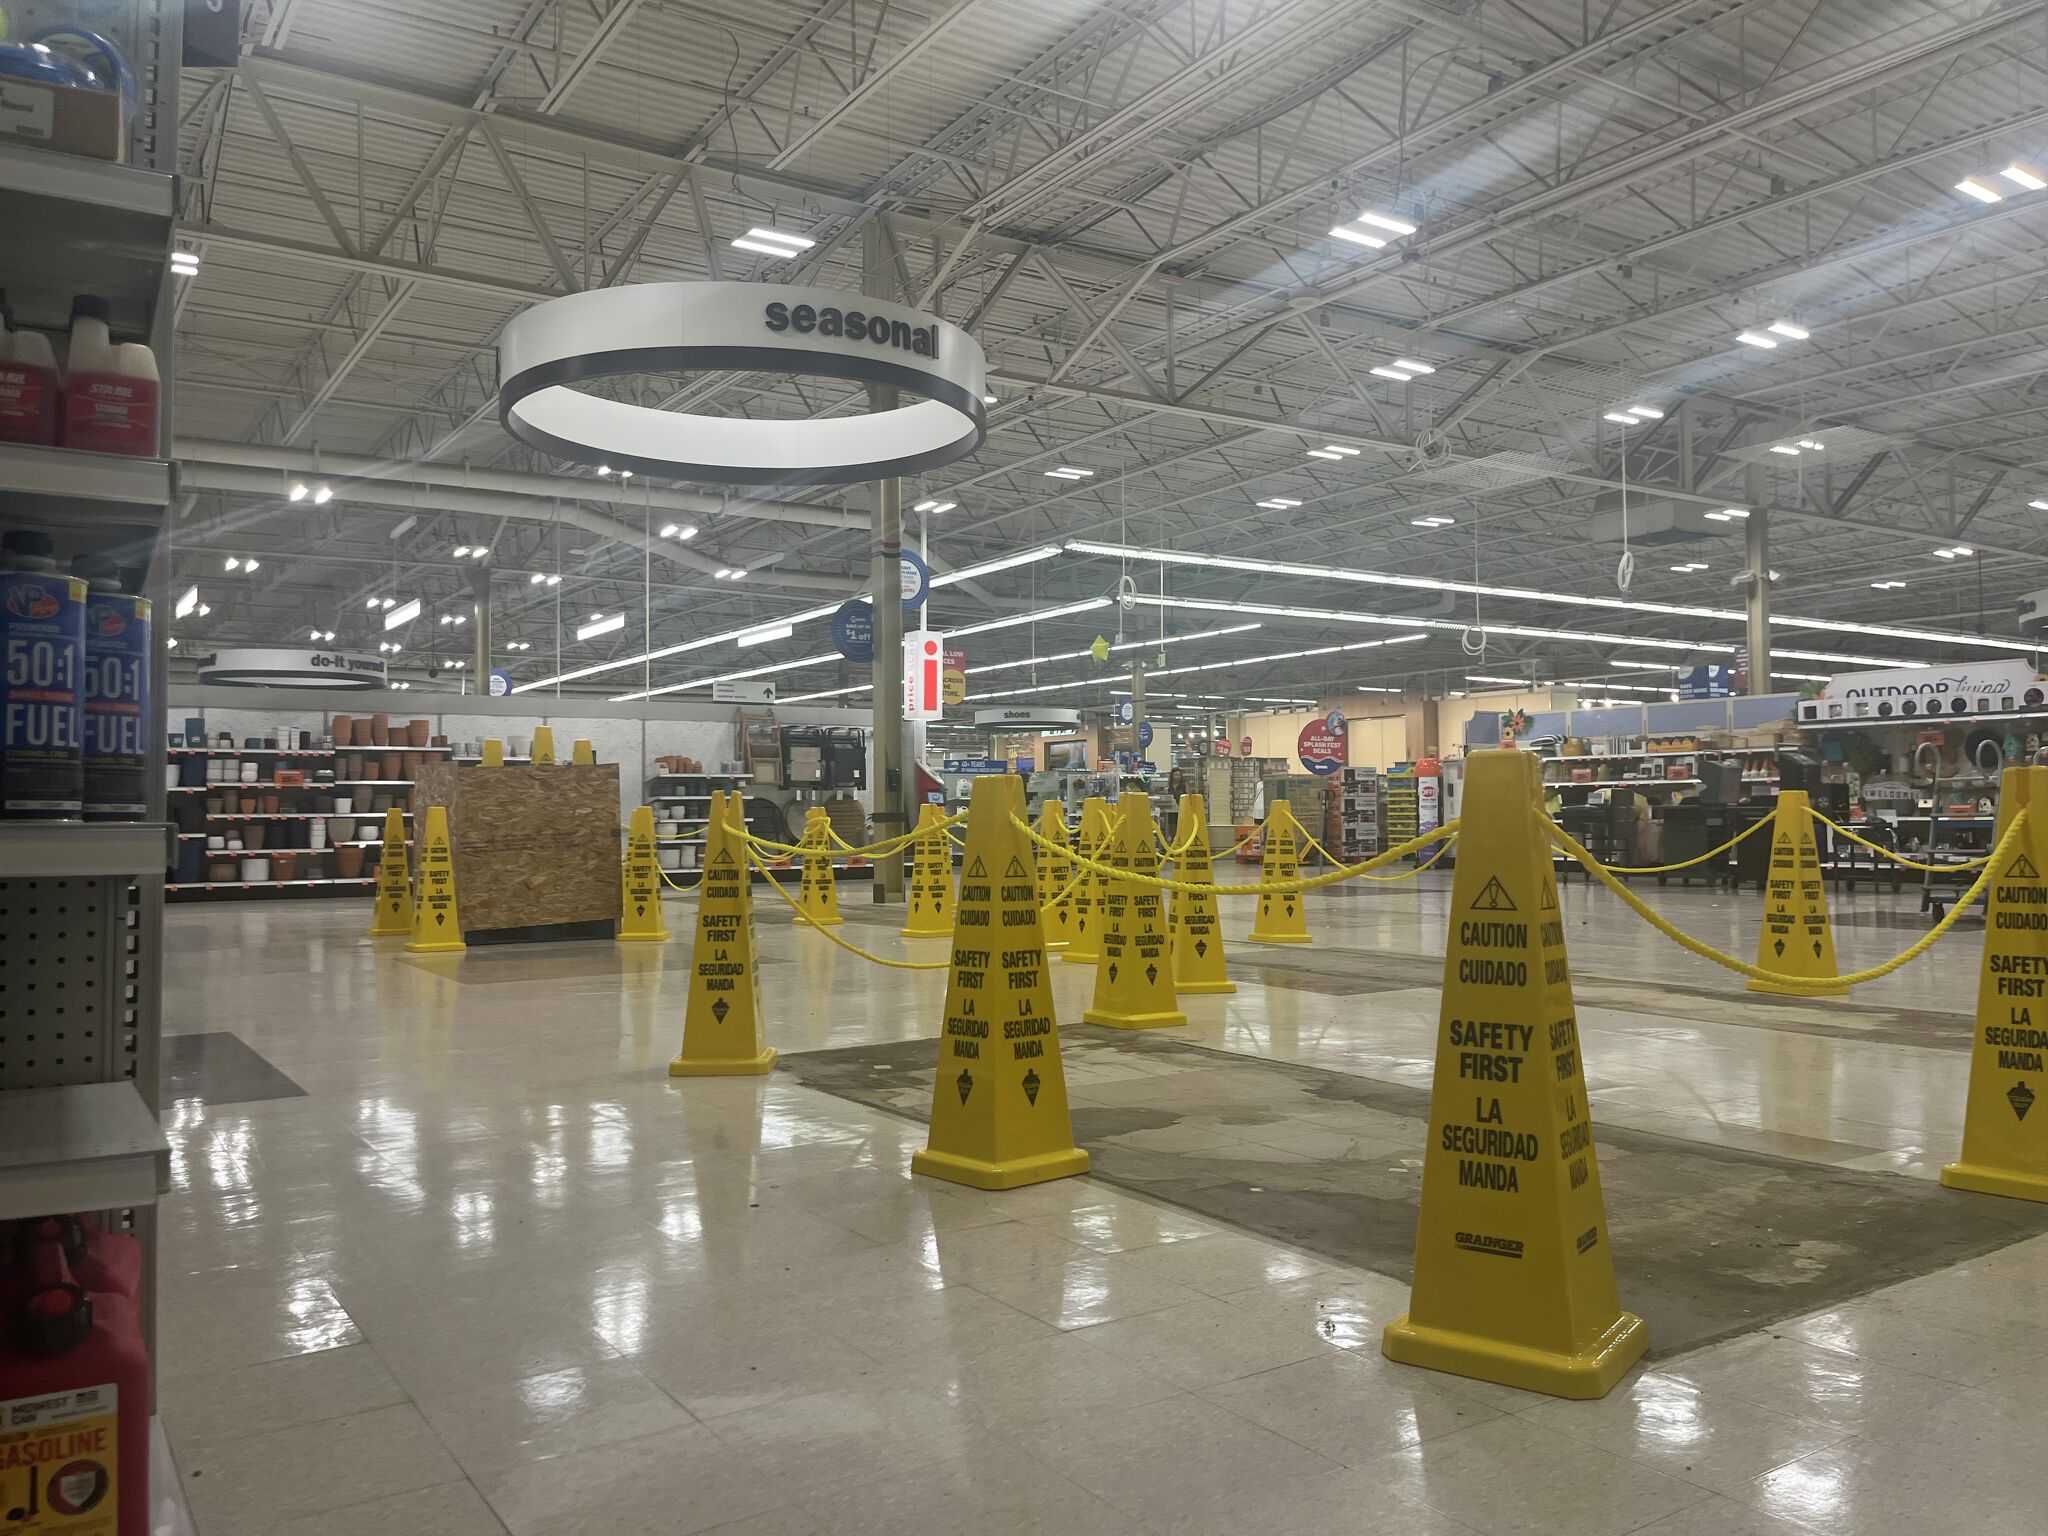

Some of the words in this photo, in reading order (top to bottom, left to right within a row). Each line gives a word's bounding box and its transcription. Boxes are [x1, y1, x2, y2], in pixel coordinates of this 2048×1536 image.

[765, 302, 939, 359] seasonal
[7, 640, 74, 689] 50:1
[311, 654, 345, 668] do-it
[1003, 711, 1031, 719] shoes
[6, 703, 80, 749] FUEL
[1134, 858, 1154, 867] CAUTION
[1186, 850, 1207, 858] CAUTION
[708, 869, 739, 881] CAUTION
[707, 886, 739, 898] CUIDADO
[962, 885, 991, 902] CAUTION
[1001, 885, 1034, 902] CAUTION
[1770, 880, 1795, 889] SAFETY
[1802, 881, 1820, 889] SAFETY
[1108, 895, 1127, 906] SAFETY
[1134, 895, 1159, 906] SAFETY
[1189, 893, 1207, 901] FIRST
[1772, 891, 1791, 899] FIRST
[1997, 886, 2047, 904] CAUTION
[1110, 907, 1124, 917] FIRST
[1138, 907, 1157, 917] FIRST
[1195, 905, 1203, 914] LA
[1777, 904, 1785, 913] LA
[1809, 905, 1816, 913] LA
[703, 915, 741, 927] SAFETY
[960, 910, 989, 927] CUIDADO
[1002, 909, 1036, 927] CUIDADO
[1184, 915, 1214, 925] SEGURIDAD
[1996, 911, 2048, 931] CUIDADO
[707, 930, 736, 942] FIRST
[1112, 923, 1119, 932] LA
[1144, 923, 1153, 933] LA
[1460, 922, 1527, 949] CAUTION
[1541, 920, 1563, 949] CAUTION
[1135, 935, 1164, 946] SEGURIDAD
[715, 949, 727, 961] LA
[955, 949, 990, 968] SAFETY
[1002, 949, 1041, 969] SAFETY
[1141, 948, 1160, 958] MANDA
[699, 963, 743, 976] SEGURIDAD
[1459, 959, 1527, 987] CUIDADO
[1545, 958, 1567, 986] CUIDADO
[707, 978, 735, 991] MANDA
[957, 970, 984, 989] FIRST
[1009, 970, 1038, 989] FIRST
[1998, 977, 2045, 998] FIRST
[963, 999, 974, 1016] LA
[1019, 999, 1032, 1016] LA
[2011, 1007, 2031, 1026] LA
[948, 1017, 989, 1039] SEGURIDAD
[1004, 1017, 1050, 1039] SEGURIDAD
[1450, 1019, 1534, 1052] SAFETY
[1549, 1017, 1575, 1051] SAFETY
[1985, 1026, 2048, 1050] SEGURIDA
[954, 1040, 979, 1060] MANDA
[1014, 1040, 1043, 1061] MANDA
[1460, 1053, 1523, 1084] FIRST
[1556, 1051, 1576, 1082] FIRST
[1998, 1050, 2043, 1072] MANDA
[1476, 1096, 1503, 1125] LA
[1566, 1094, 1576, 1121] LA
[1442, 1125, 1538, 1161] SEGURIDAD
[1560, 1121, 1590, 1160] SEGURIDAD
[1459, 1159, 1519, 1194] MANDA
[1570, 1158, 1588, 1192] MANDA
[1455, 1231, 1524, 1253] GRAINGER
[1577, 1226, 1597, 1251] GRAINGER
